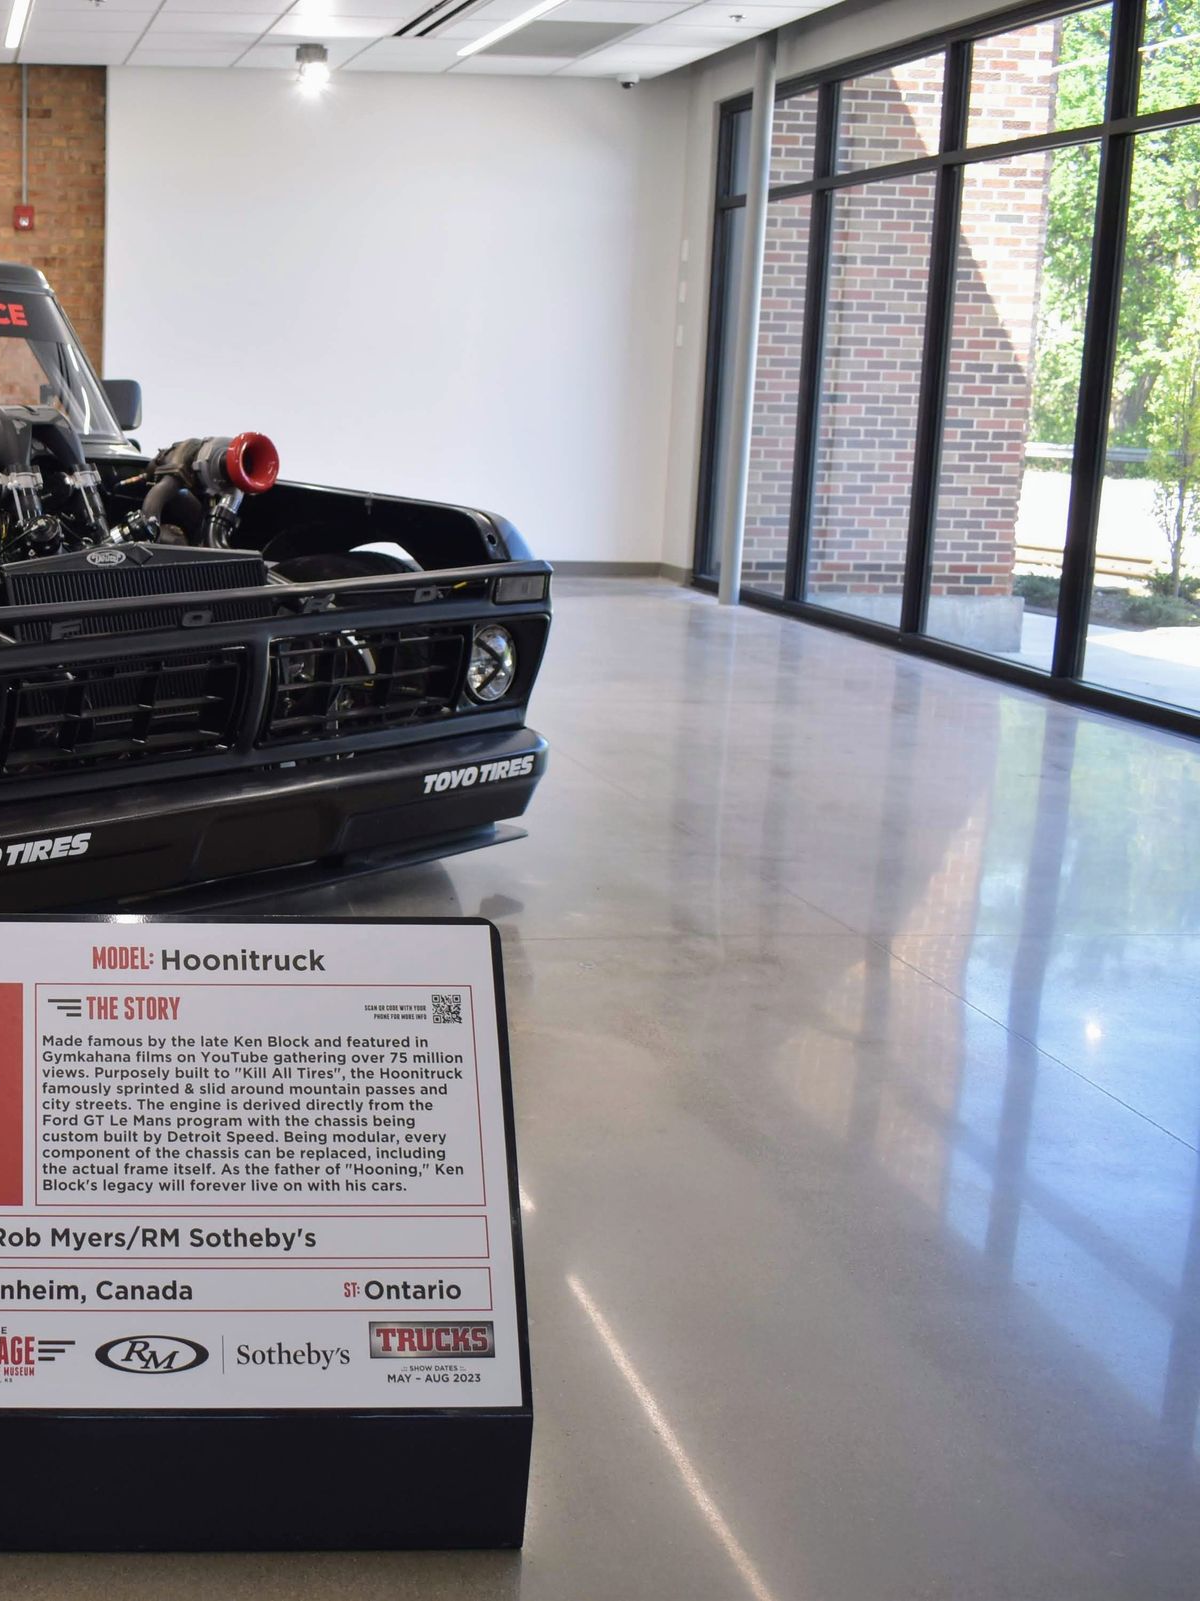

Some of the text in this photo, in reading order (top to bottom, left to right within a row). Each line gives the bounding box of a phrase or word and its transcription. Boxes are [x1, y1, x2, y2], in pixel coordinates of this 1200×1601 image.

[423, 754, 535, 794] TOYO TIRES
[5, 832, 92, 867] TIRES
[92, 945, 326, 972] MODEL: Hoonitruck
[85, 996, 181, 1021] THE STORY
[42, 1034, 429, 1050] Made famous by the late Ken Block and featured in
[42, 1050, 464, 1066] Gymkahana films on YouTube gathering over 75 million
[42, 1065, 90, 1079] views.
[94, 1066, 170, 1081] Purposely
[174, 1066, 210, 1079] built
[213, 1067, 231, 1079] to
[271, 1066, 292, 1080] All
[349, 1066, 375, 1080] the
[379, 1067, 463, 1080] Hoonitruck
[42, 1146, 446, 1162] component of the chassis can be replaced, including
[41, 1162, 68, 1175] the
[71, 1162, 119, 1175] actual
[123, 1162, 169, 1176] frame
[173, 1162, 216, 1176] itself.
[220, 1163, 241, 1176] As
[244, 1162, 270, 1176] the
[274, 1162, 321, 1176] father
[324, 1162, 342, 1176] of
[434, 1163, 464, 1176] Ken
[42, 1178, 407, 1194] Block's legacy will forever live on with his cars.
[50, 1225, 180, 1252] Myers/RM
[189, 1227, 317, 1252] Sotheby's
[95, 1279, 193, 1301] Canada
[343, 1279, 462, 1301] ST: Ontario
[375, 1327, 489, 1353] TRUCKS
[236, 1341, 351, 1371] Sotheby's
[3, 1366, 35, 1377] MUSEUM
[409, 1364, 459, 1372] SHOW DATES
[387, 1373, 482, 1384] MAY AUG 2023
